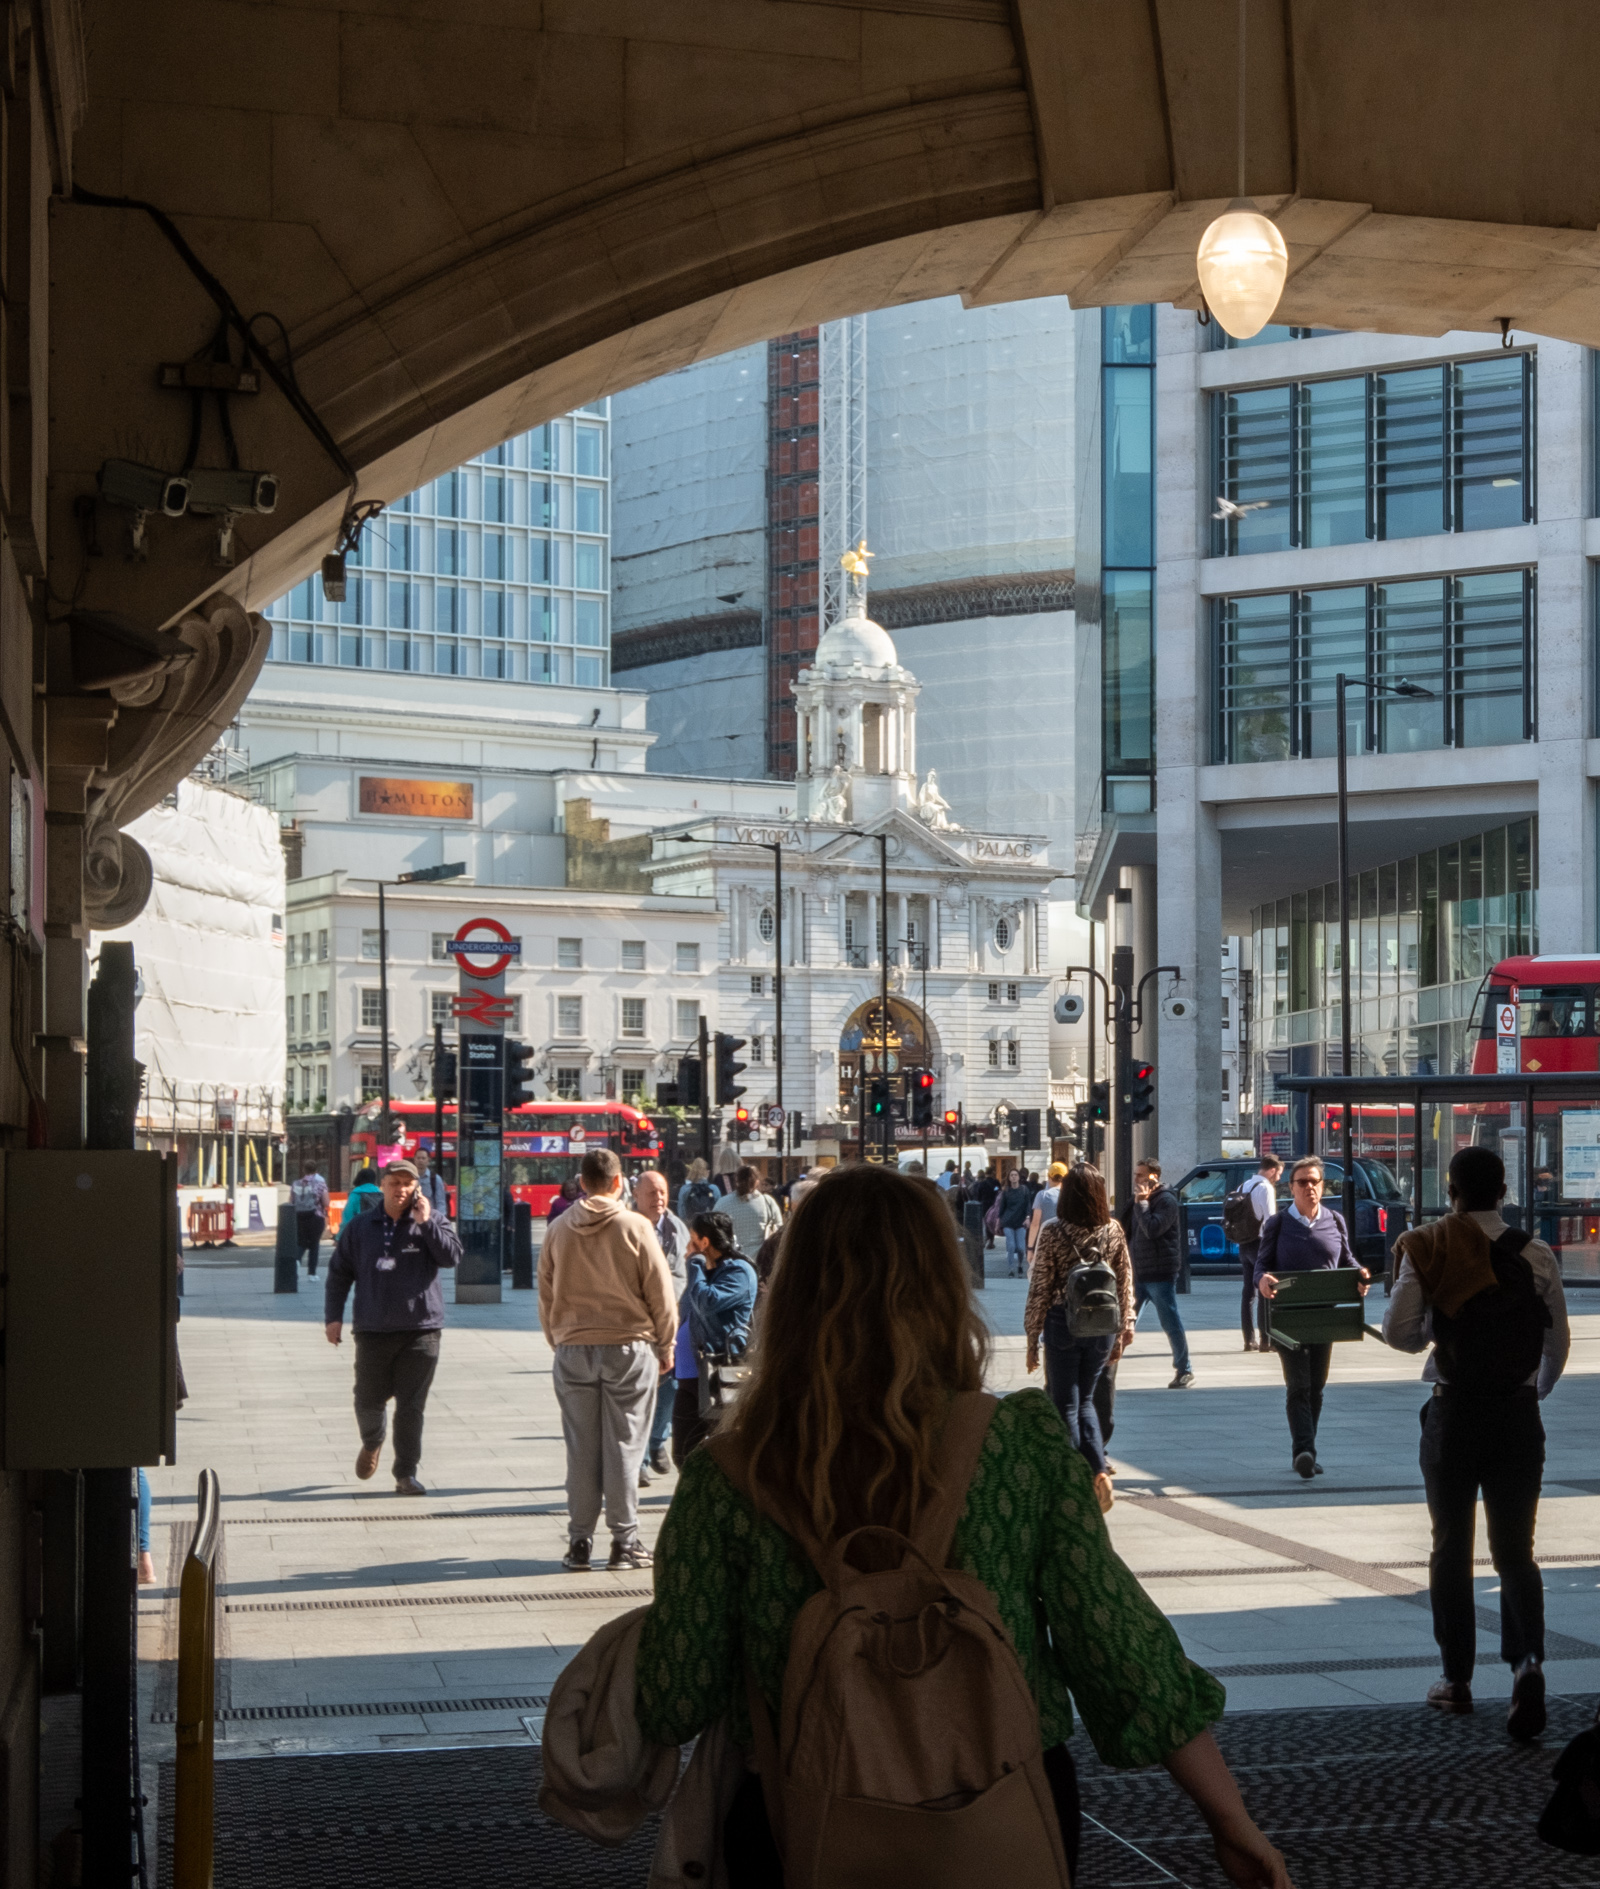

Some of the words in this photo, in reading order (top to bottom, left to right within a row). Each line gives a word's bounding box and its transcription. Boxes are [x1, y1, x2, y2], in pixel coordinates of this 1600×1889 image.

[734, 827, 802, 846] VICTORIA
[977, 841, 1032, 858] PALACE
[447, 943, 519, 952] UNDERGROUND
[468, 1043, 496, 1051] Victoria
[469, 1051, 495, 1059] Station
[770, 1111, 782, 1122] 20
